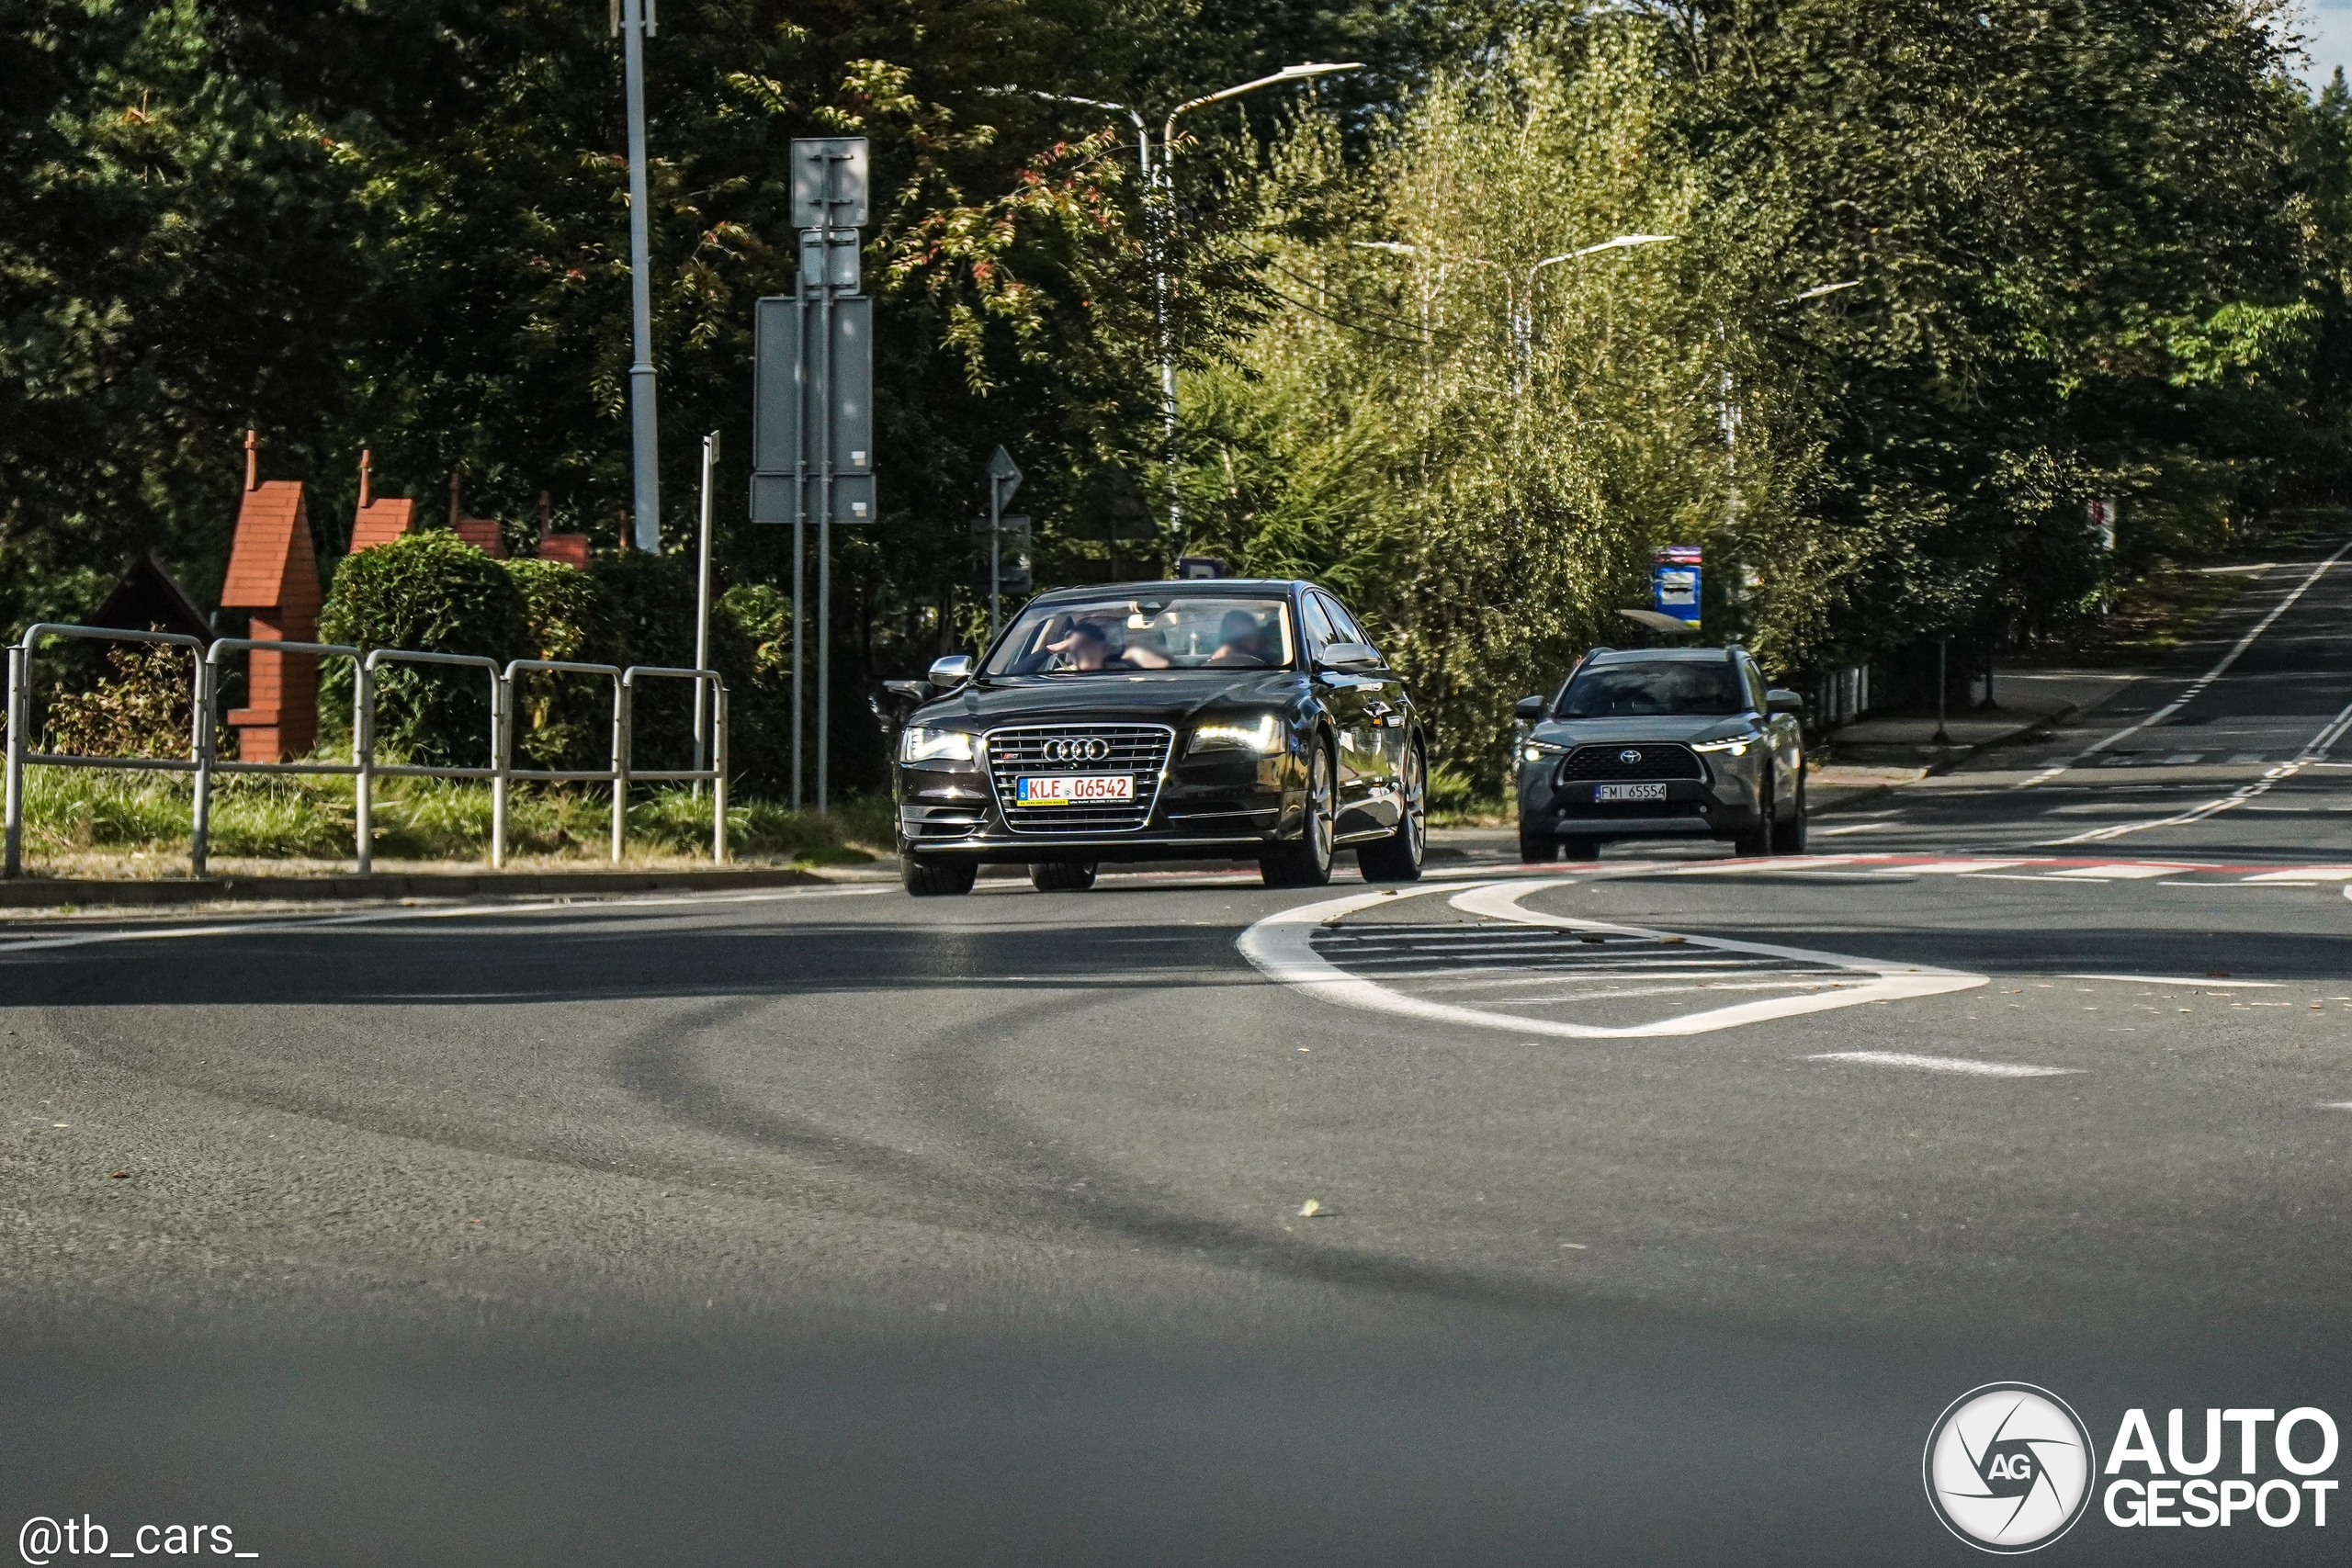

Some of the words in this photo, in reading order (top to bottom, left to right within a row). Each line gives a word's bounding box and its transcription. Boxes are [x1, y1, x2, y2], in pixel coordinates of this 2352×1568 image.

[1029, 780, 1061, 799] KLE
[1075, 778, 1127, 797] 06542
[1601, 785, 1623, 798] FMI
[1628, 784, 1666, 798] 65554
